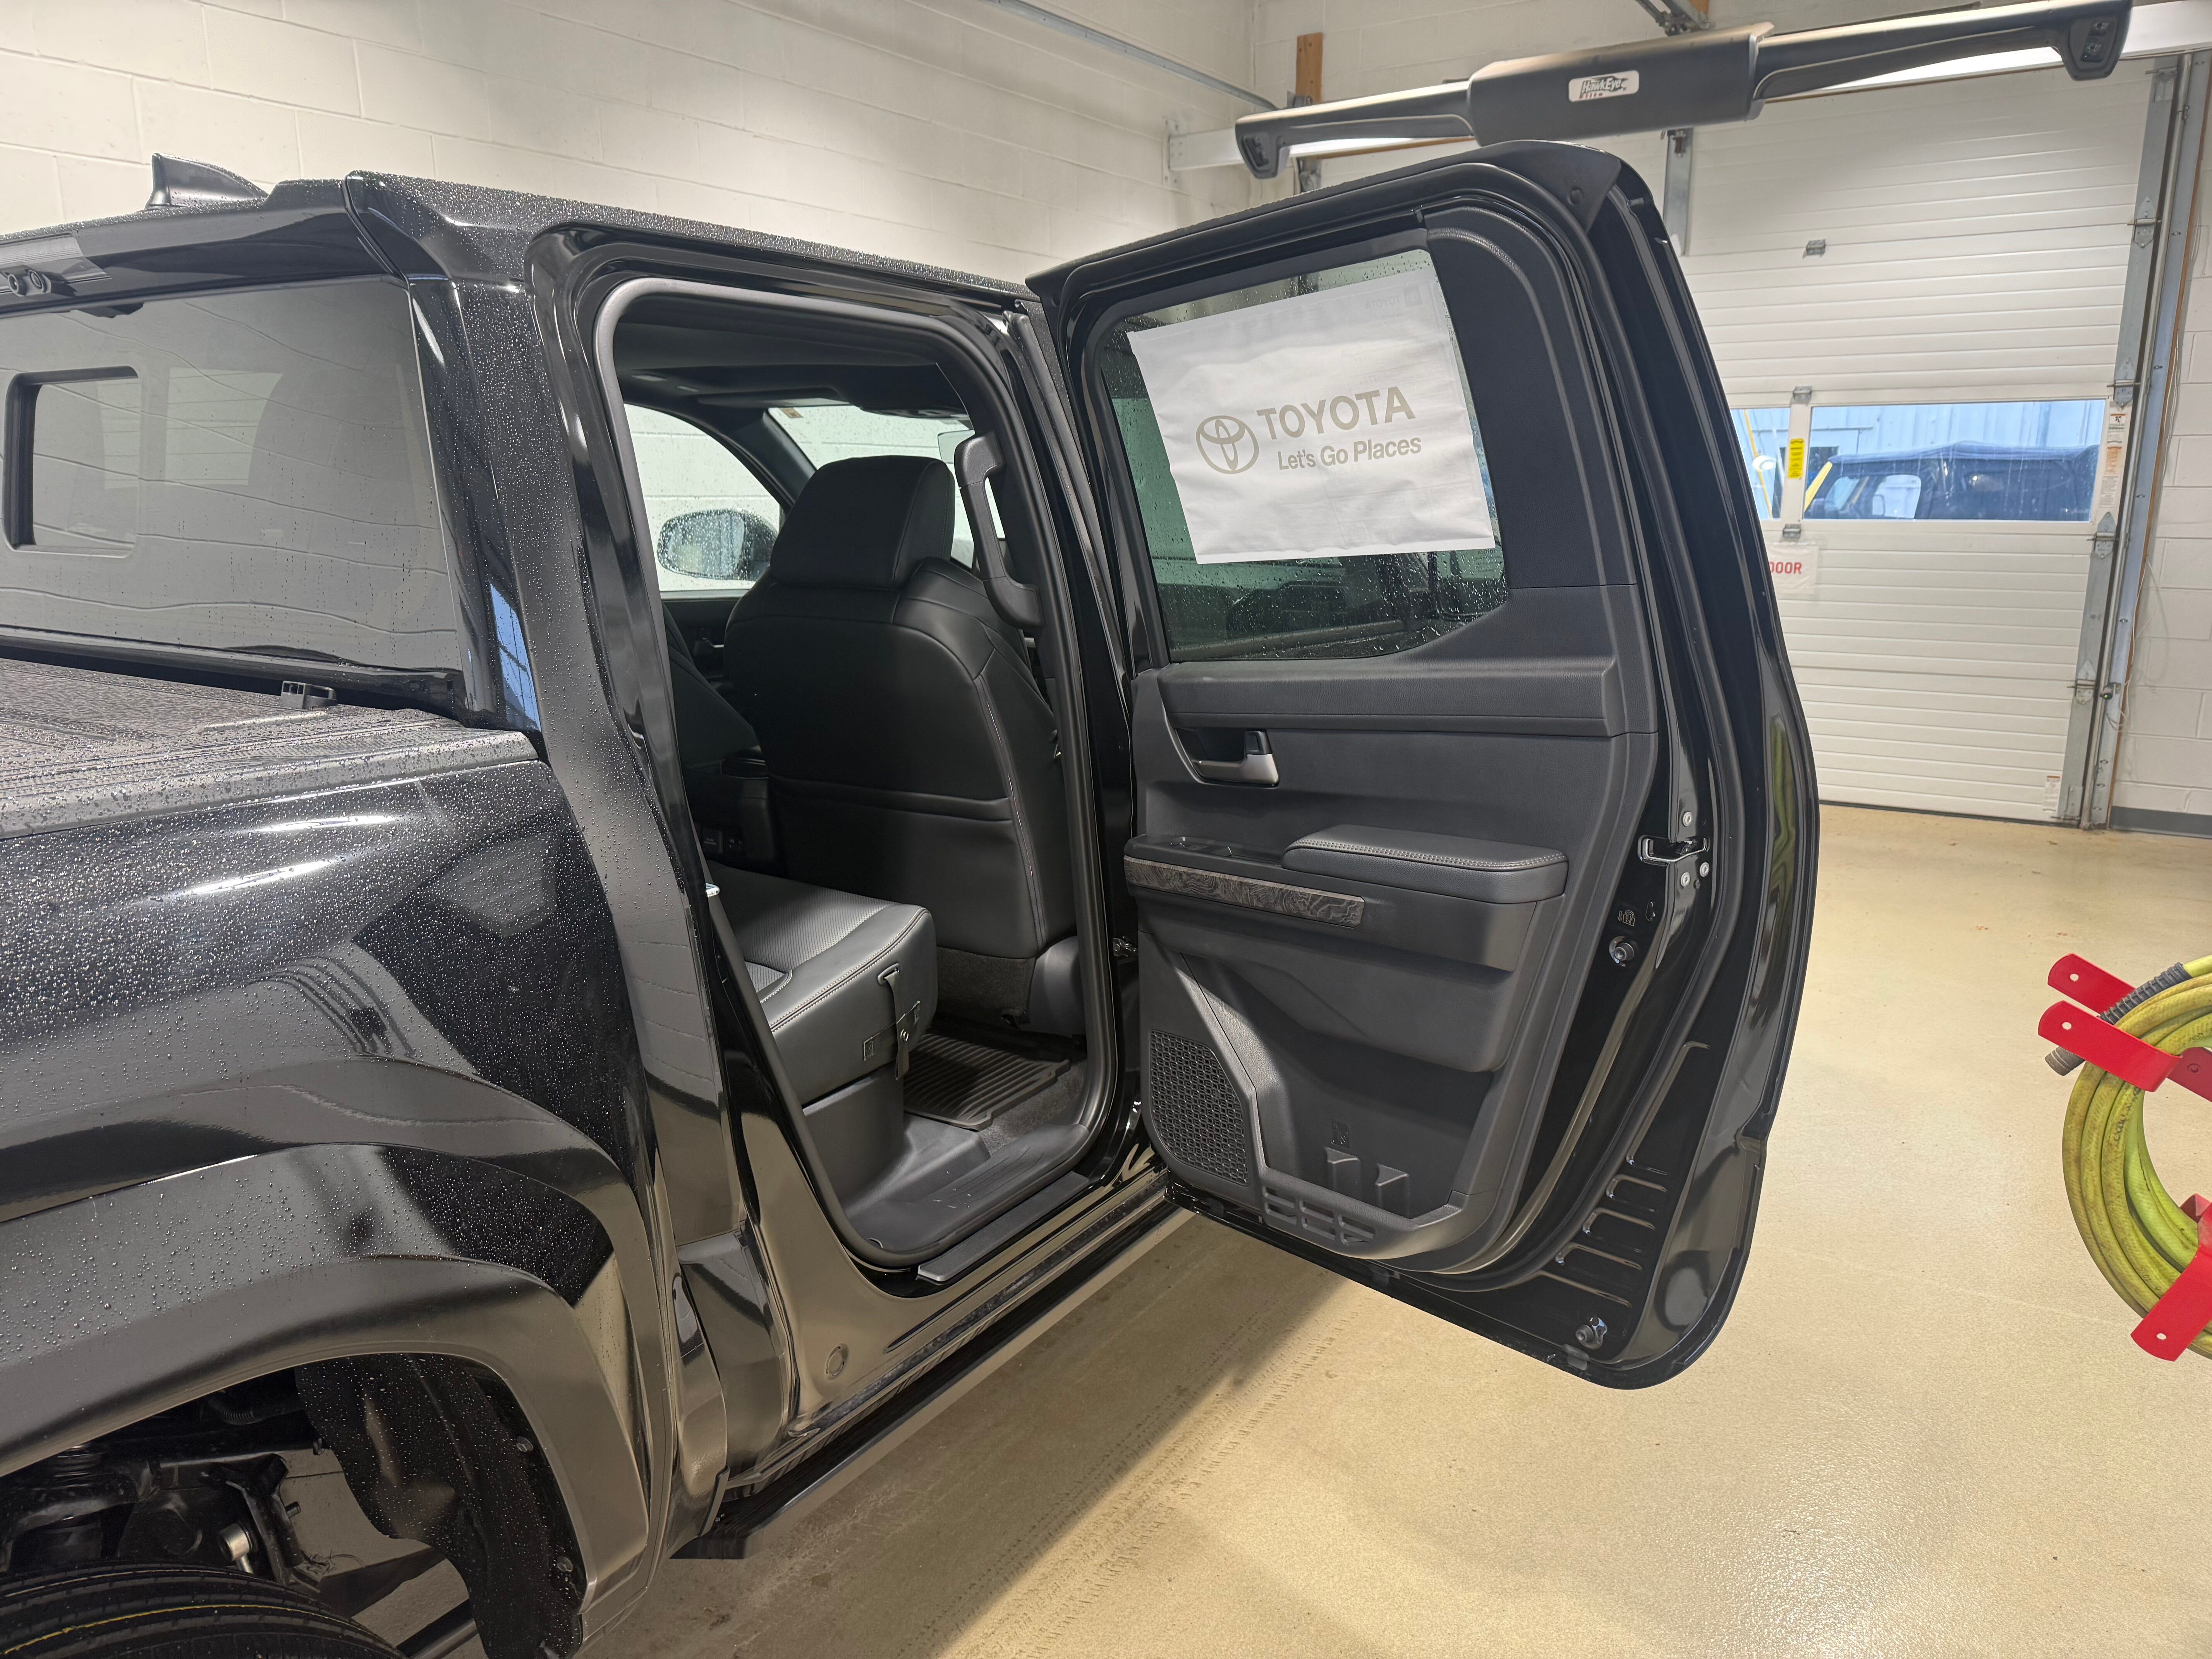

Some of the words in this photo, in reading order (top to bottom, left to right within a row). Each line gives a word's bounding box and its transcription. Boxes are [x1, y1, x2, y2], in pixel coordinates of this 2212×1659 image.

[1582, 77, 1622, 93] HawkEye
[1256, 386, 1416, 440] TOYOTA
[1278, 449, 1316, 470] Let's
[1320, 445, 1348, 466] Go
[1353, 437, 1422, 462] Places
